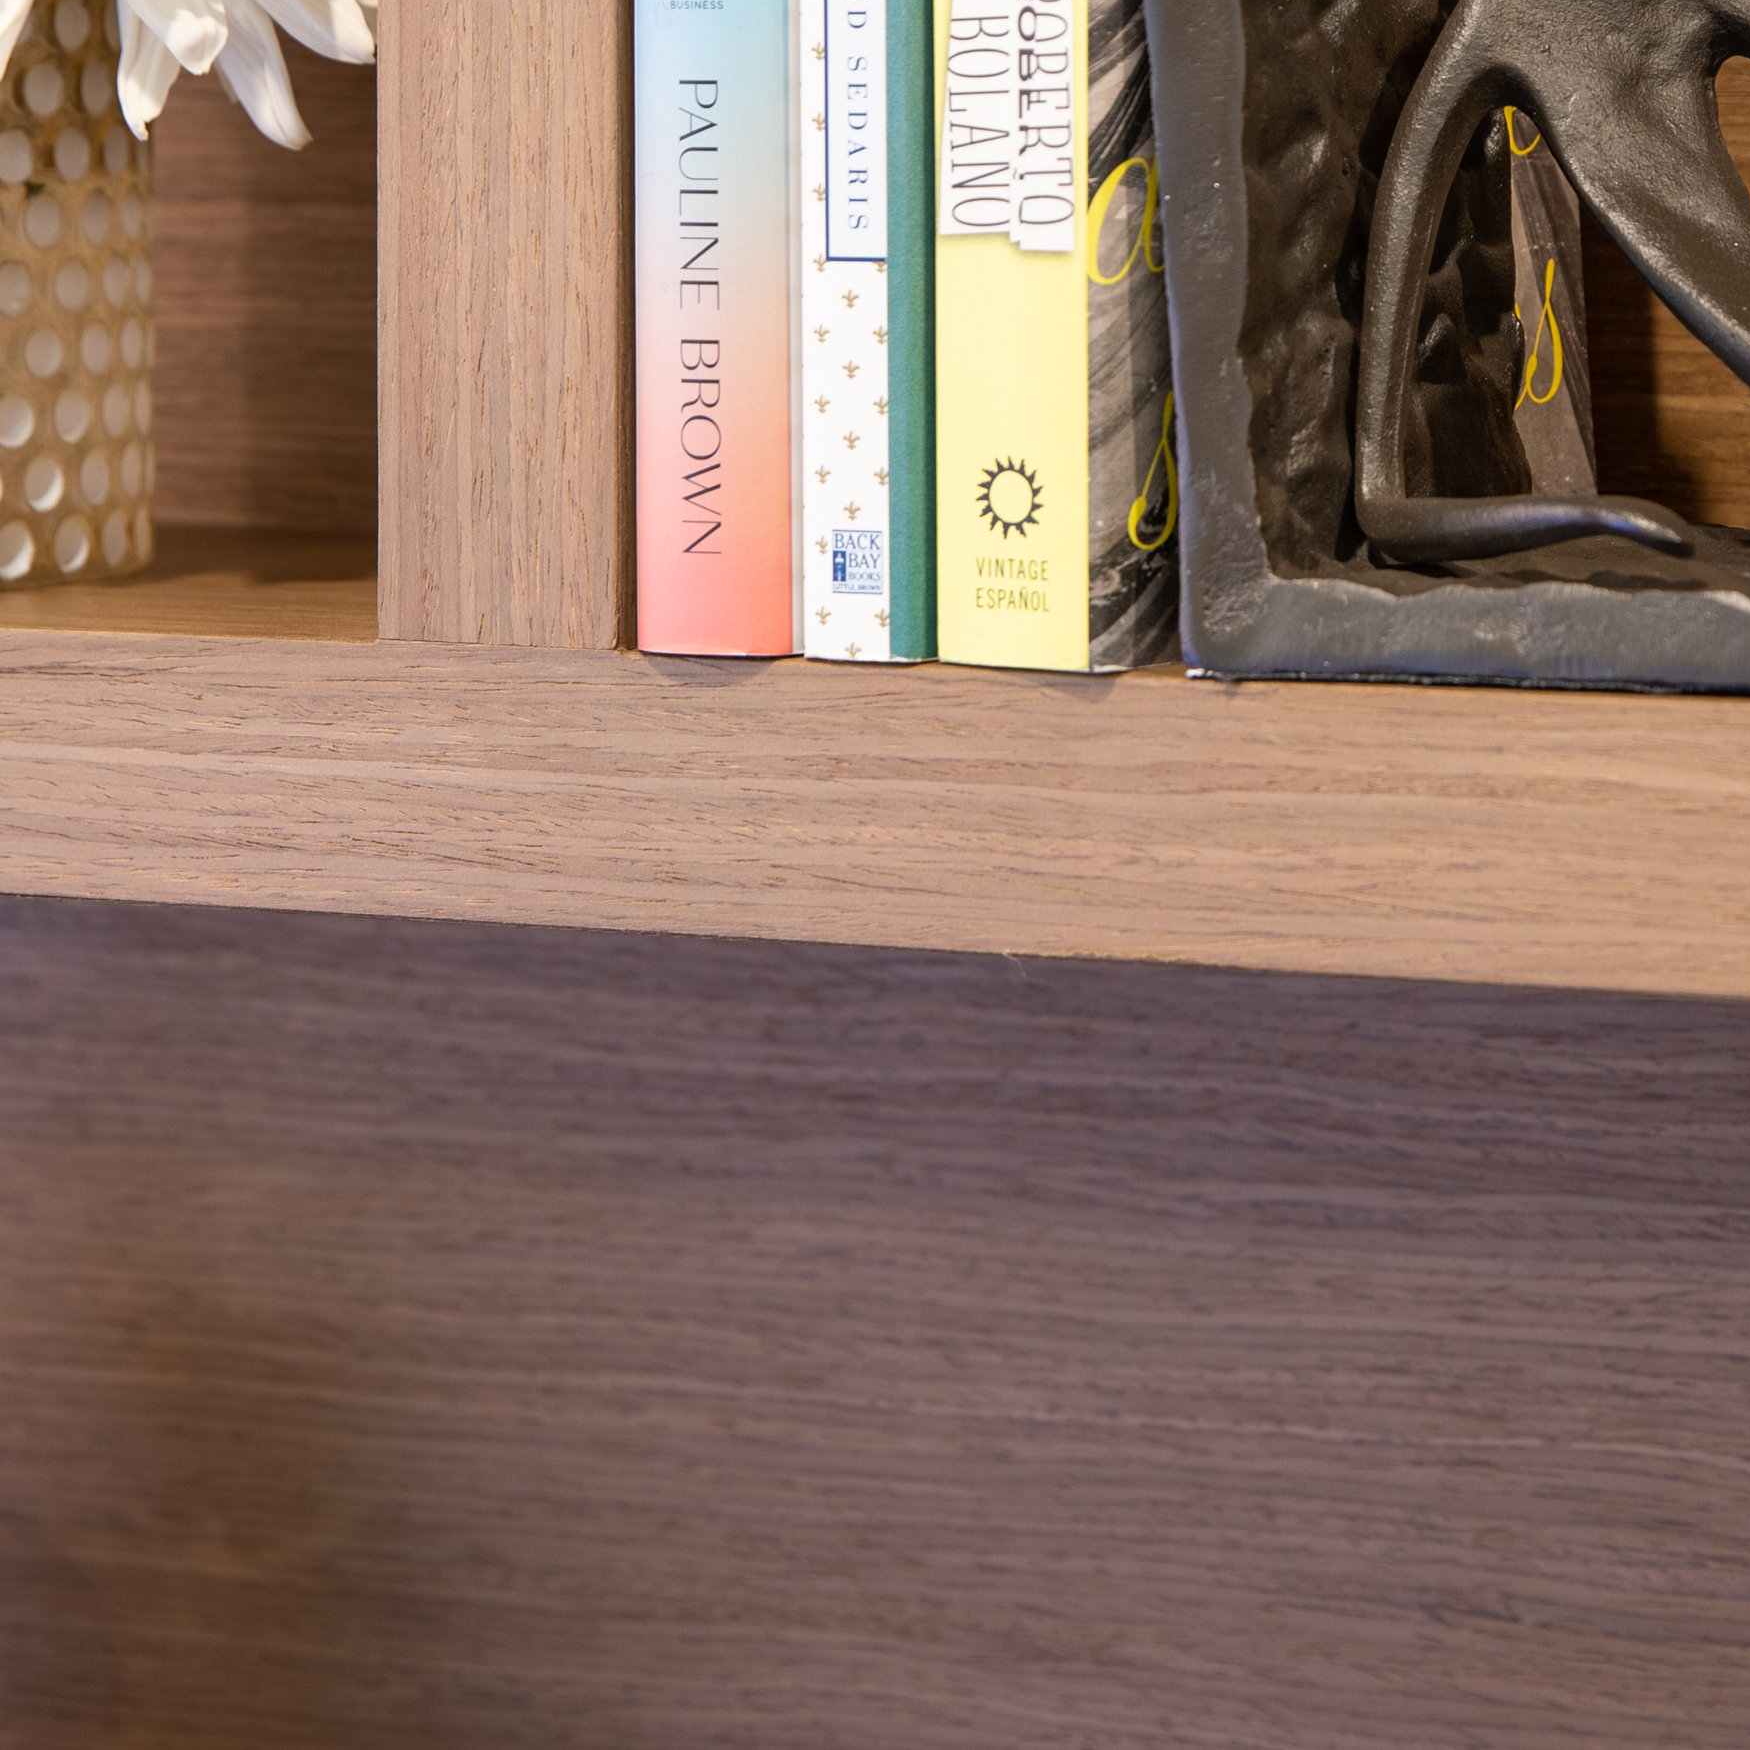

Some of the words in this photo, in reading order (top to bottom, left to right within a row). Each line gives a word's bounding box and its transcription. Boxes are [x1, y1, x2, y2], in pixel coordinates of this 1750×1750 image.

[669, 0, 725, 10] BUSINESS
[847, 54, 870, 231] SEDARIS
[678, 79, 720, 311] PAULINE
[679, 339, 723, 555] BROWN
[834, 533, 881, 550] BACK
[848, 552, 881, 569] BAY
[975, 556, 1050, 582] VINTAGE
[848, 571, 882, 581] BOOKS
[975, 585, 1051, 612] ESPAÑOL
